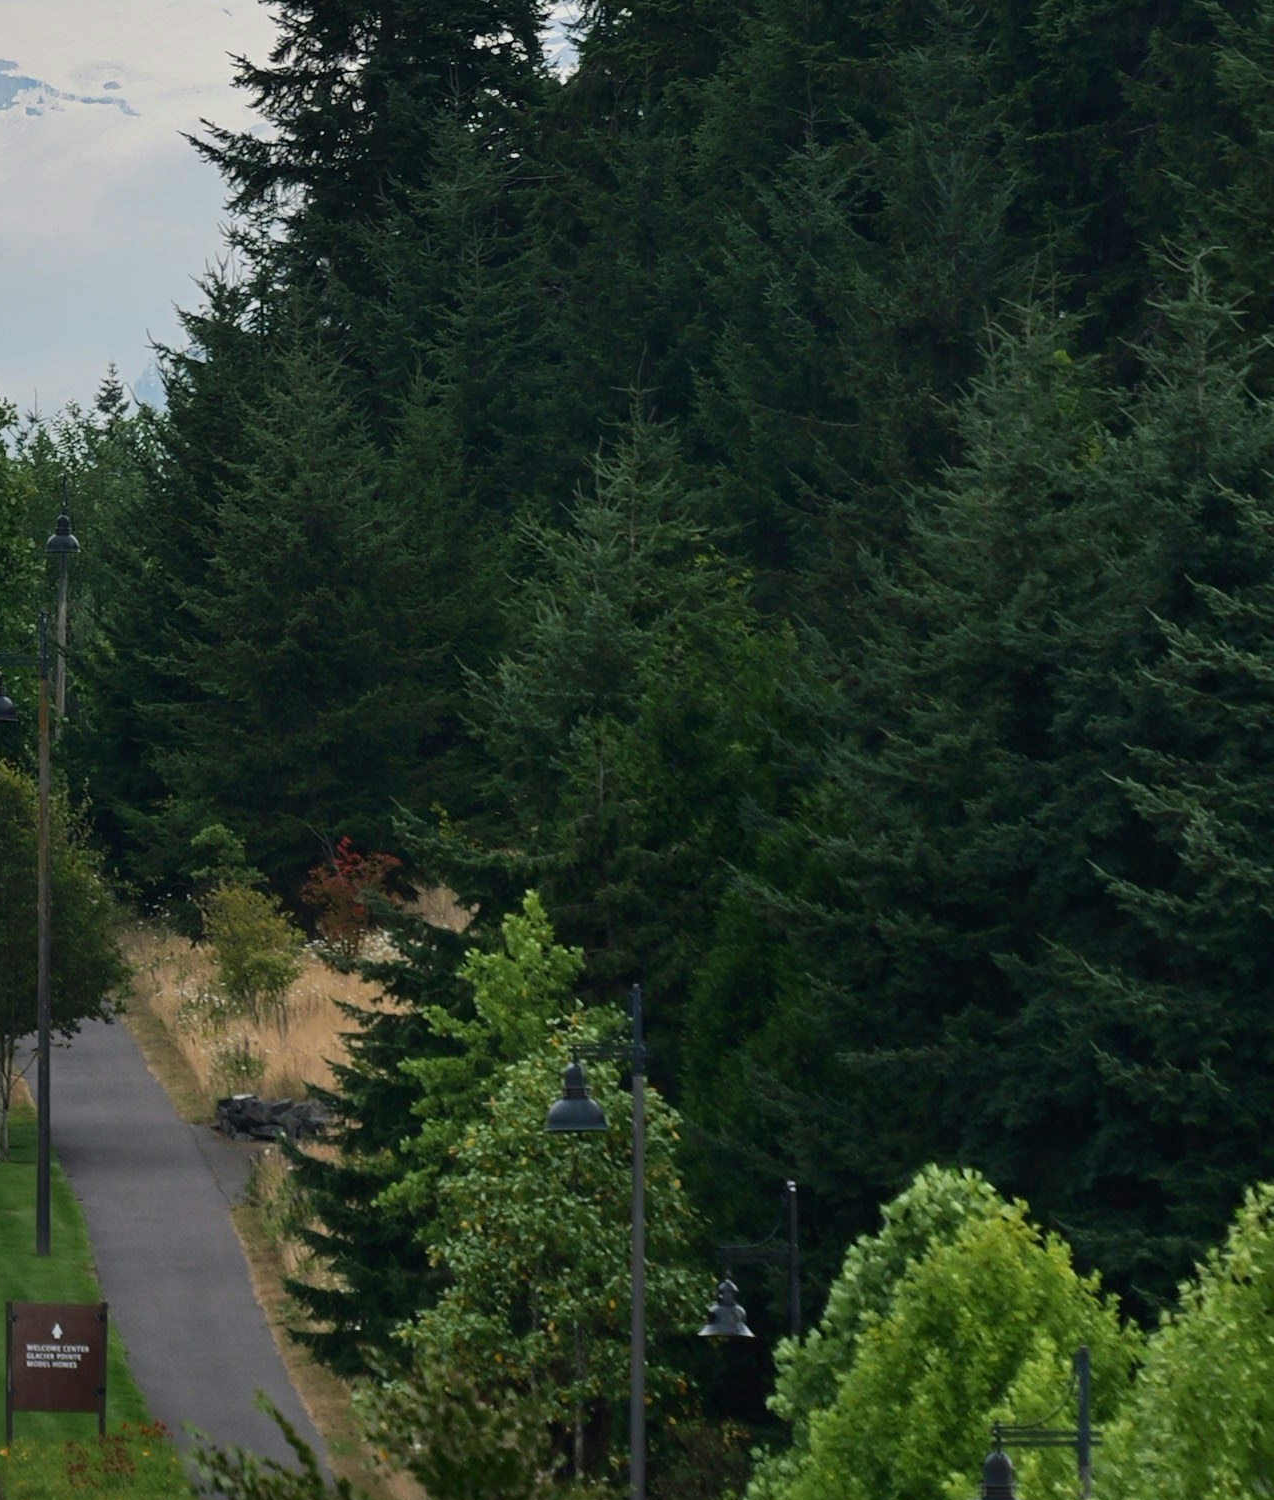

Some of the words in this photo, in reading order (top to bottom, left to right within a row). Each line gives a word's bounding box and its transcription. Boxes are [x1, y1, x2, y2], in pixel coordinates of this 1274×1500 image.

[26, 1344, 61, 1352] WELCOME
[62, 1345, 89, 1353] CENTER
[26, 1352, 55, 1360] GLACIER
[26, 1360, 51, 1368] MODEL
[52, 1361, 78, 1369] HOMES
